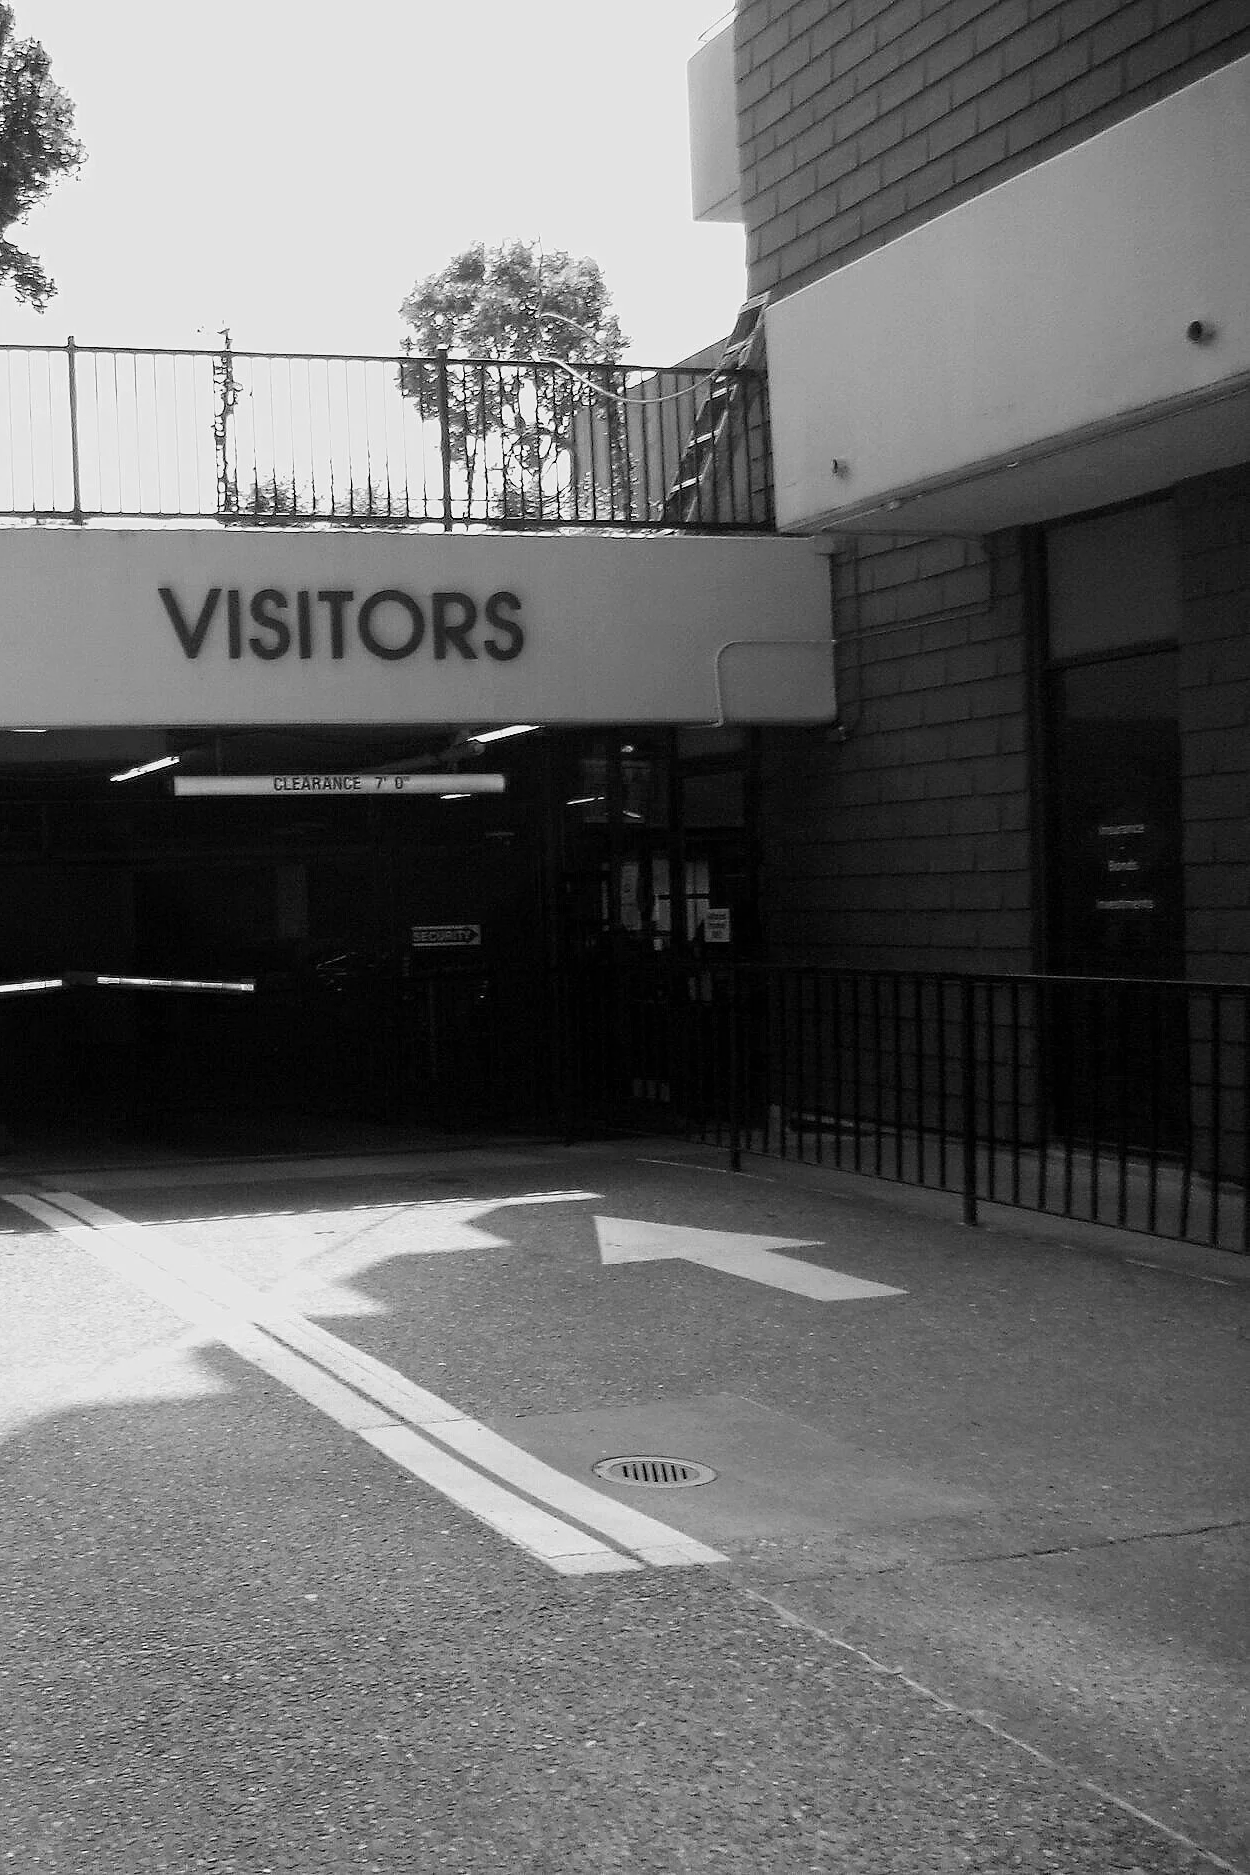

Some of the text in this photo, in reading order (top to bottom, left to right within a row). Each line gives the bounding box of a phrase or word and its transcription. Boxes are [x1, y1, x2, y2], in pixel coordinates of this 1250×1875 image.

[157, 588, 524, 661] VISITORS
[273, 776, 362, 791] CLEARANCE
[374, 776, 387, 790] 7'
